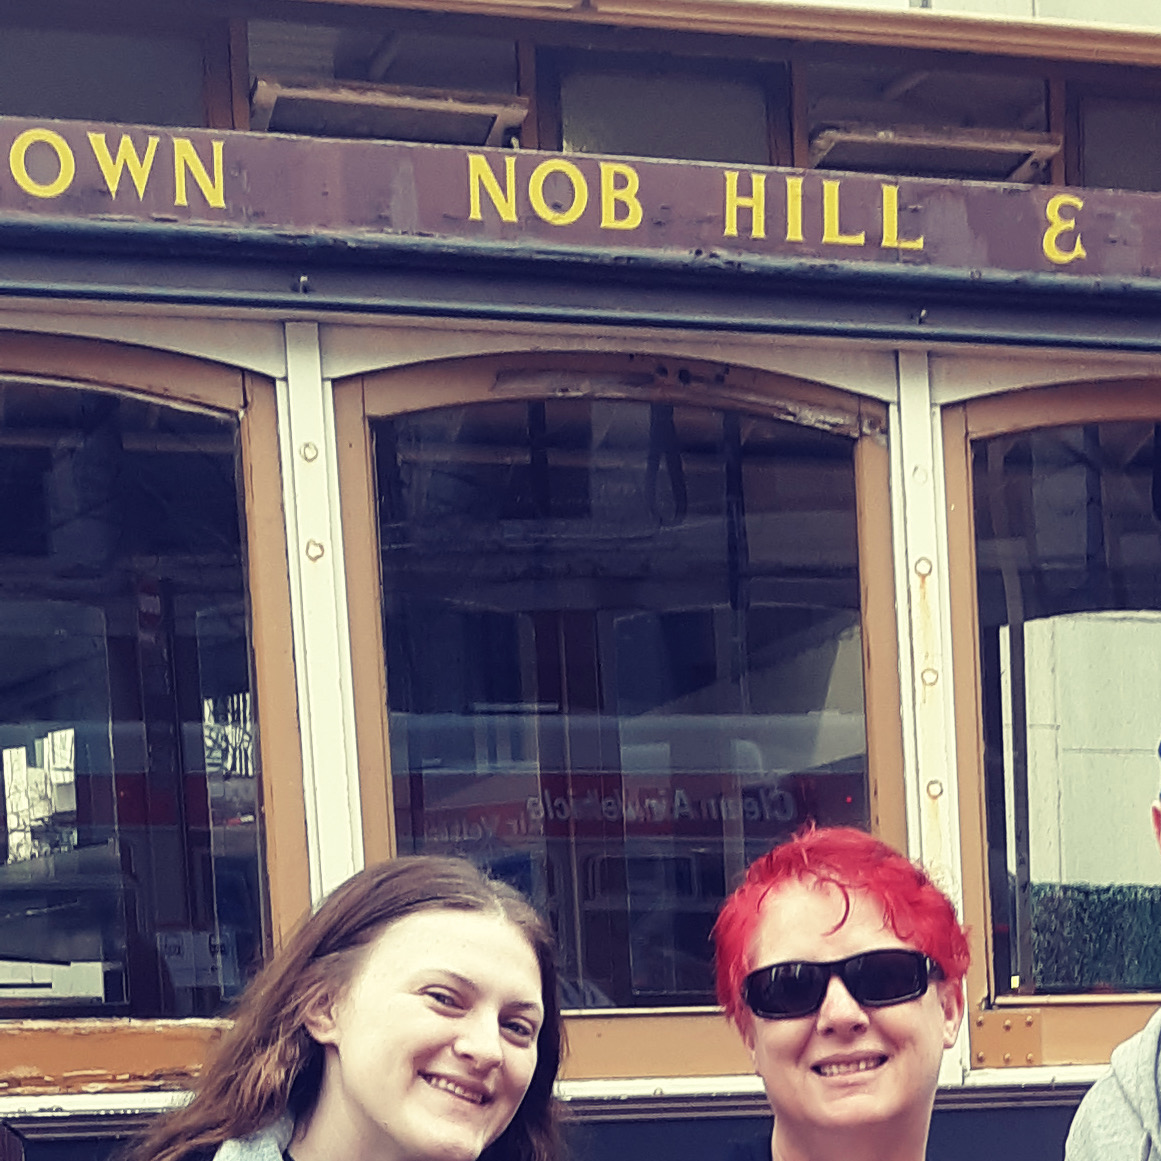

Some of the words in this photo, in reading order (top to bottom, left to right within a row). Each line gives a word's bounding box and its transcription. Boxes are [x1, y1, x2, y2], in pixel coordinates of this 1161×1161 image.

[9, 128, 226, 208] OWN
[468, 153, 644, 230] NOB
[723, 170, 925, 250] HILL
[1042, 194, 1087, 264] &
